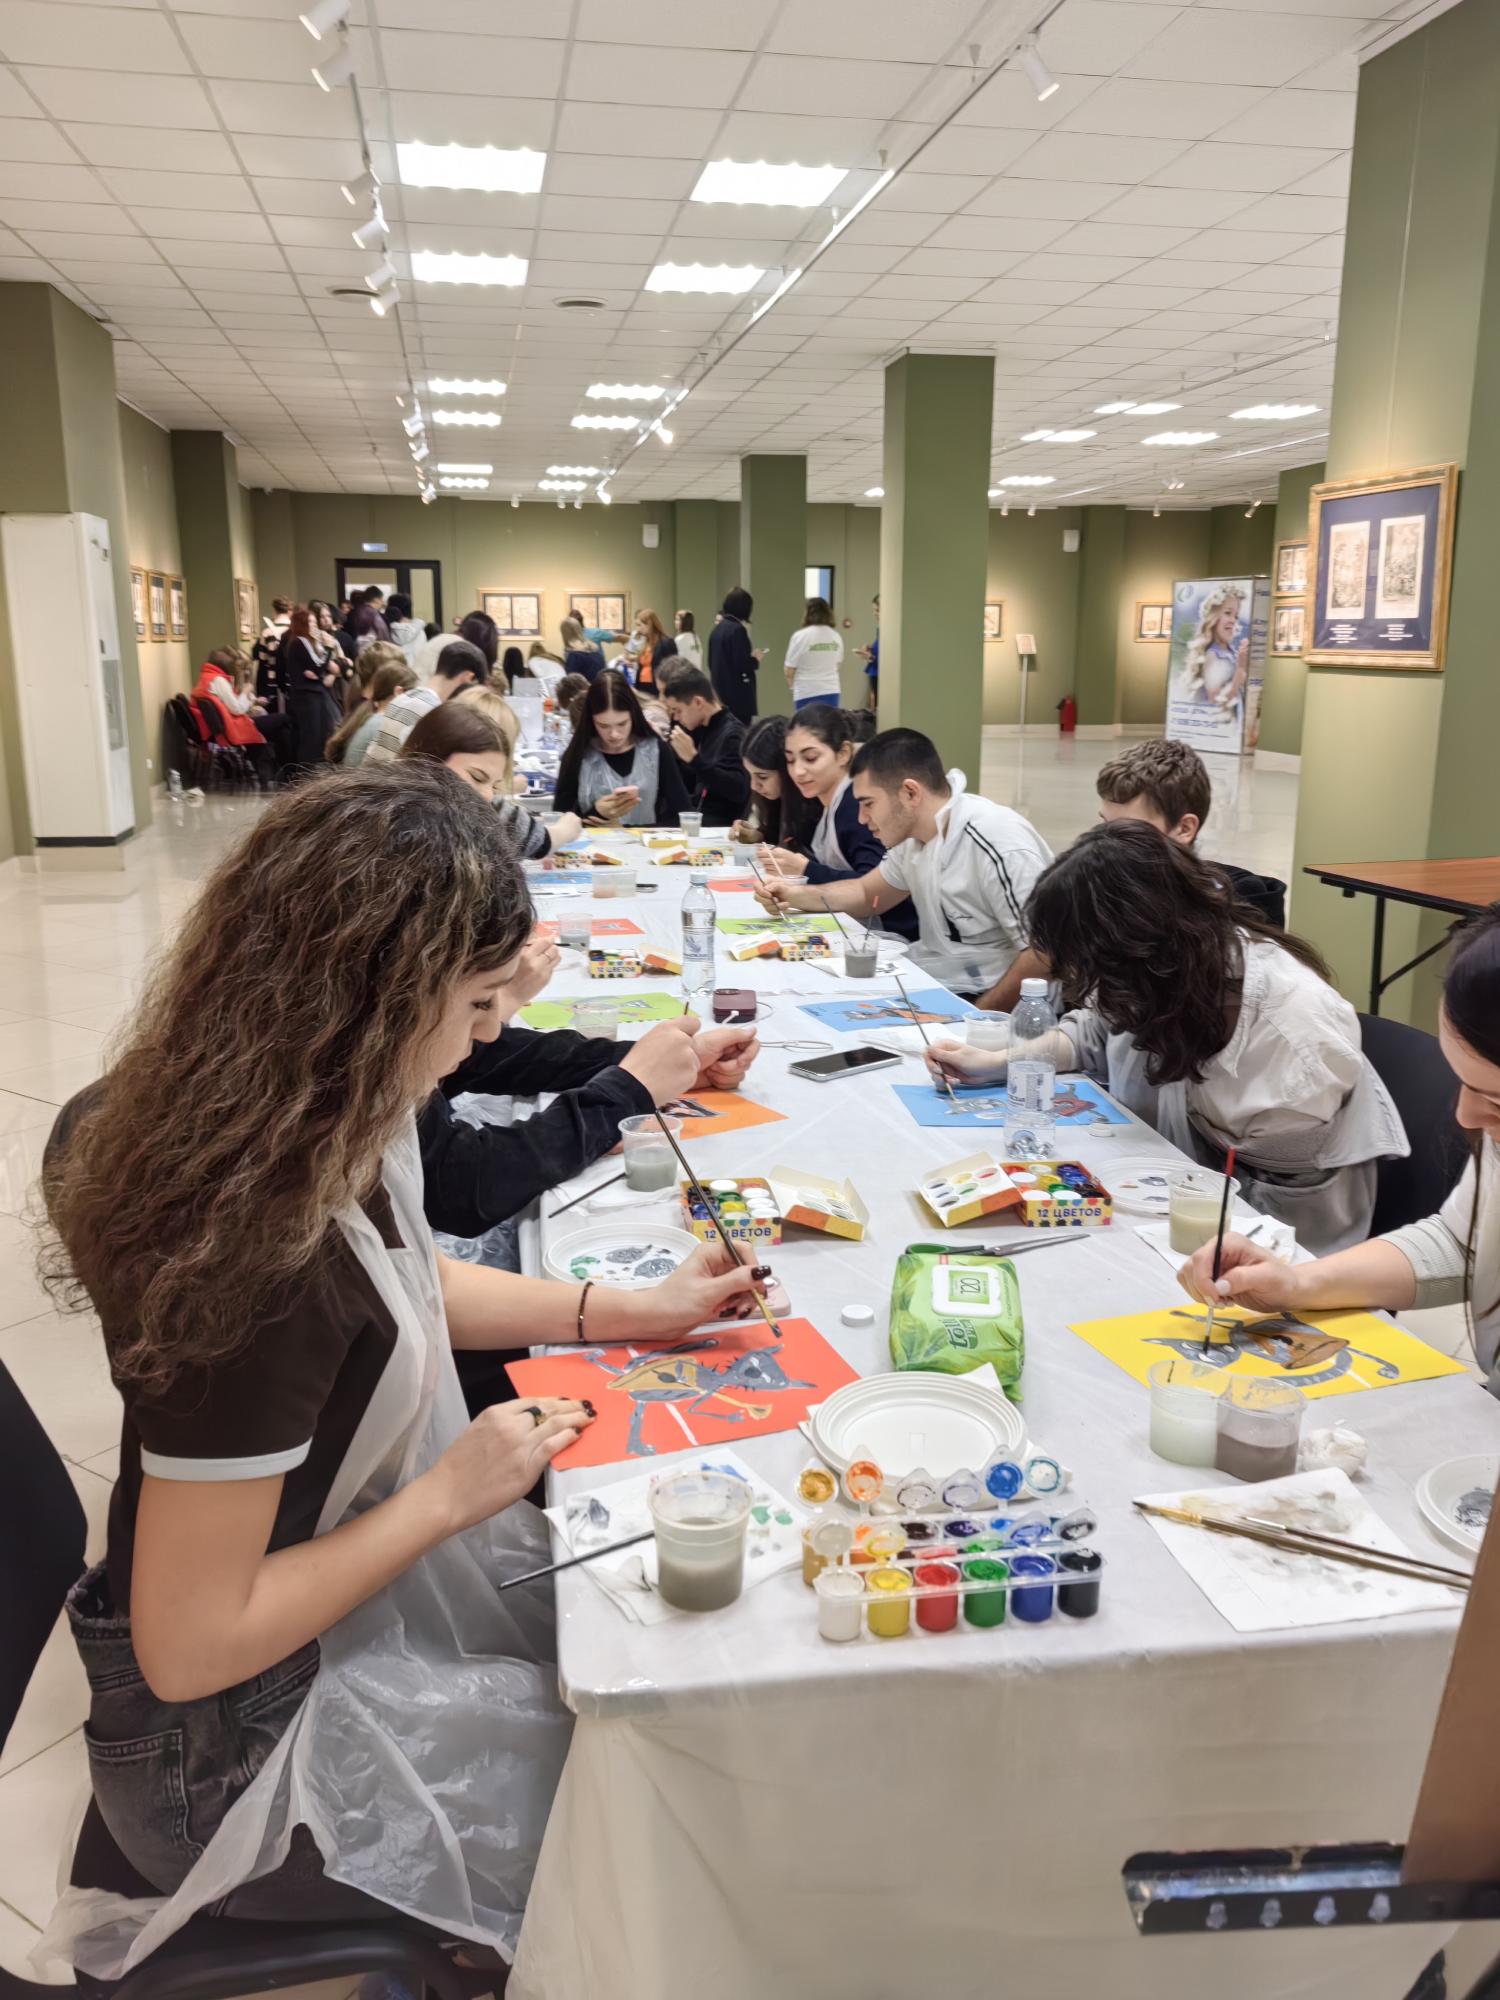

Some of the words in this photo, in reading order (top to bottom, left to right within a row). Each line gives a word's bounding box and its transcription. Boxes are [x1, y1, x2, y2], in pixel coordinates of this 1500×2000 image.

[1037, 1208, 1049, 1217] 12
[1053, 1207, 1102, 1219] ЦВЕТОВ
[704, 1230, 717, 1239] 12
[960, 1277, 981, 1295] 120
